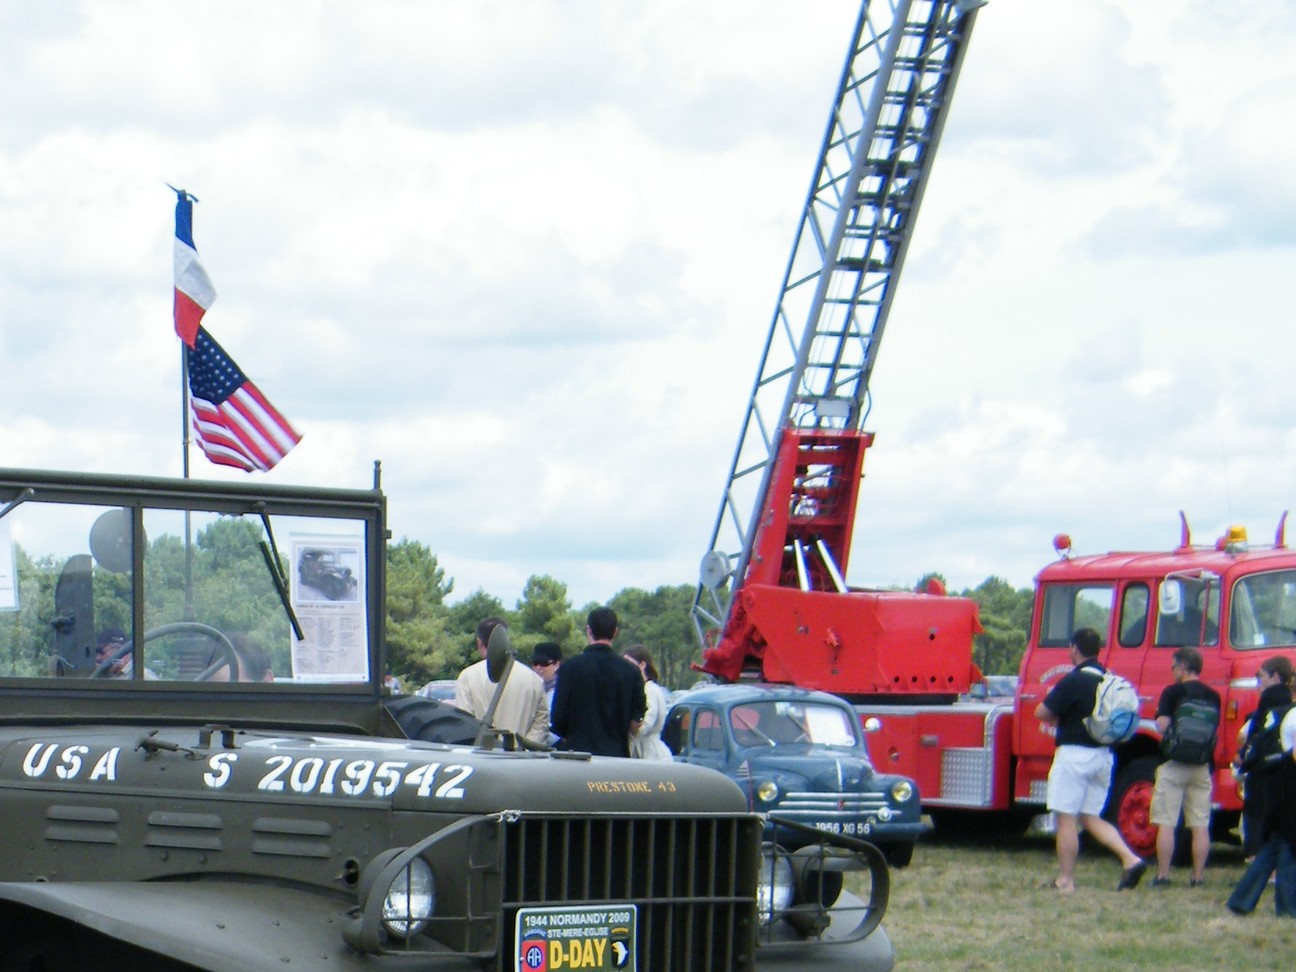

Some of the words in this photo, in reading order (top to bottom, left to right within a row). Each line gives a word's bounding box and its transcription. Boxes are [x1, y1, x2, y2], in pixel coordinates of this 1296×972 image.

[204, 753, 238, 788] S
[258, 756, 474, 798] 2019542
[587, 781, 652, 793] PRESTONE
[857, 823, 870, 834] 56
[525, 915, 547, 927] 1944
[550, 913, 607, 926] NORMANDY
[609, 912, 630, 923] 2009
[547, 927, 609, 938] STE-MERE-EGLISE
[550, 938, 607, 969] D-DAY
